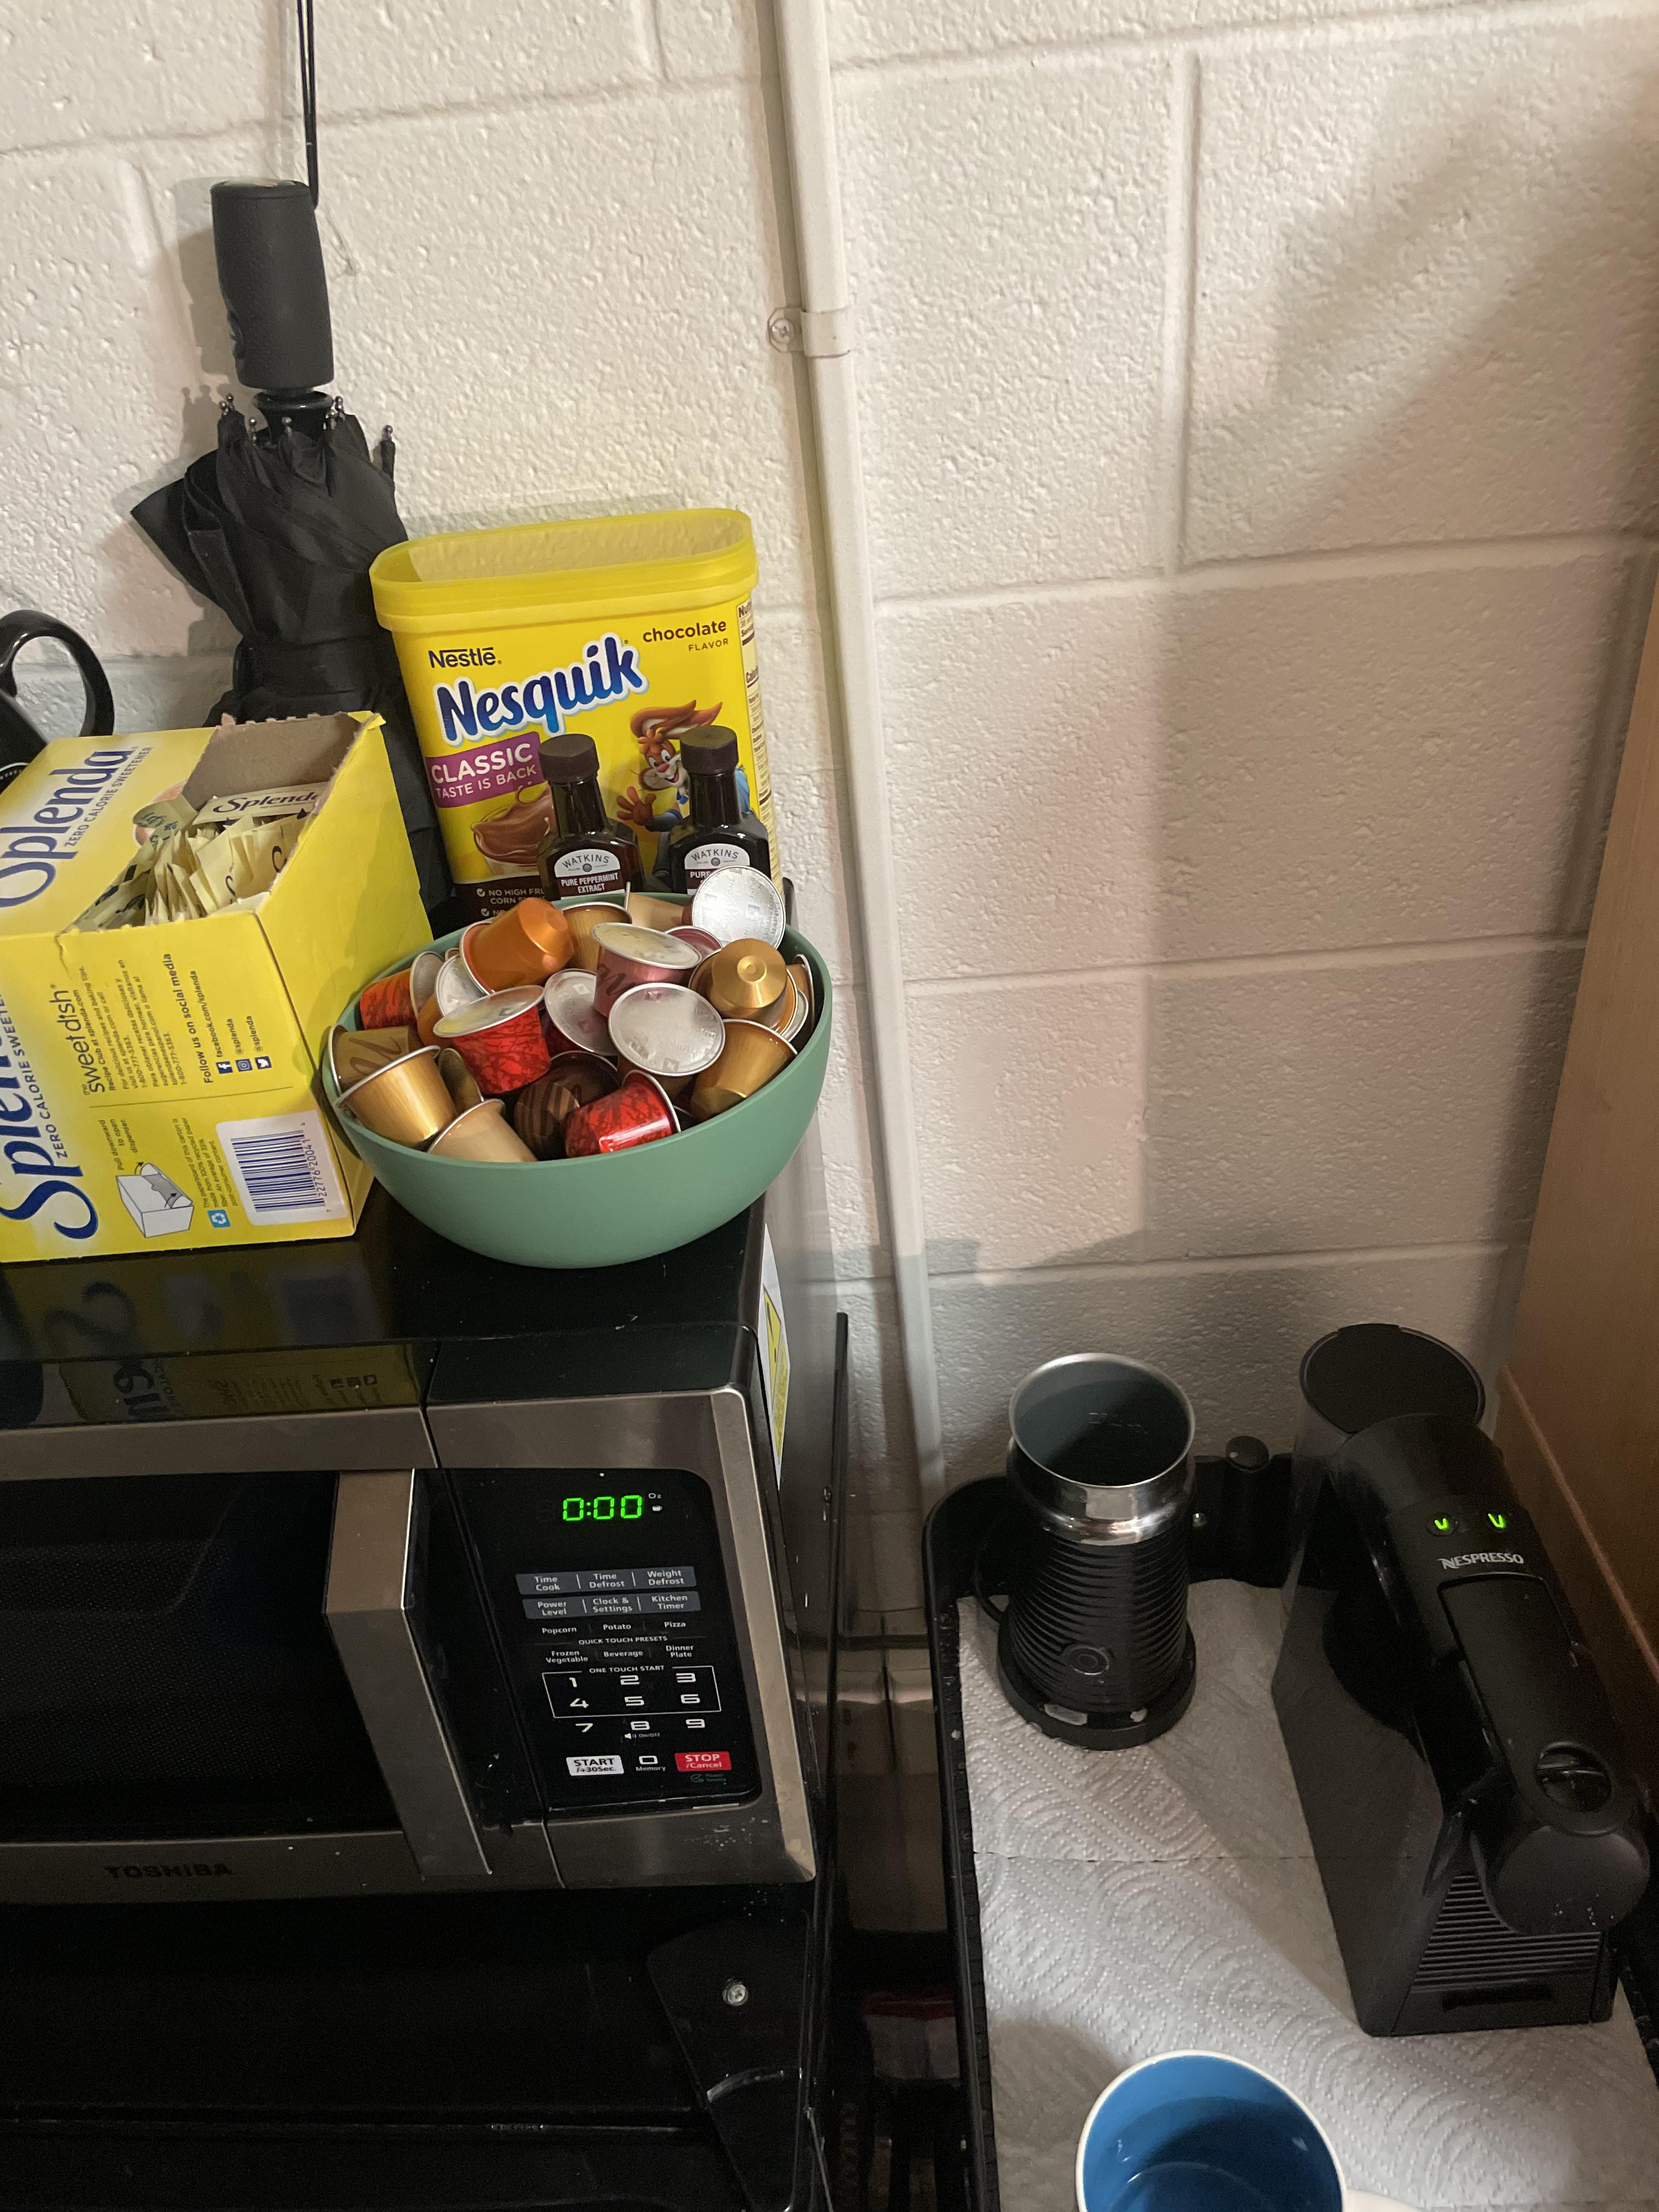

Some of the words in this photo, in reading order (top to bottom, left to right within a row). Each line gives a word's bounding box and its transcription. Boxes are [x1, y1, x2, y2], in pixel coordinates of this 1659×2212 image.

[642, 619, 727, 643] chocolate
[688, 637, 729, 652] FLAVOR
[437, 635, 646, 743] Nesquik
[431, 742, 534, 785] CLASSIC
[436, 781, 476, 799] TASTE
[478, 777, 492, 791] IS
[495, 764, 537, 788] BACK
[64, 824, 89, 847] ZERO
[84, 788, 118, 823] CALORIE
[112, 747, 154, 787] SWEETENER
[562, 854, 610, 869] WATKINS
[691, 849, 739, 861] WATKINS
[561, 878, 578, 887] PURE
[579, 872, 619, 886] PEPPERMINT
[577, 883, 605, 894] EXTRACT
[162, 953, 180, 986] media
[49, 990, 82, 1031] dish
[173, 989, 191, 1018] social
[73, 990, 95, 1037] splenda.com
[190, 970, 223, 1058] facebook.com/splenda
[187, 1022, 196, 1034] on
[245, 1015, 263, 1052] @splenda
[192, 1037, 201, 1048] us
[225, 1018, 244, 1055] @splenda
[65, 1035, 105, 1092] sweet
[95, 1048, 106, 1065] Club
[196, 1051, 213, 1084] Follow
[103, 1066, 116, 1091] Recipe
[19, 1060, 51, 1120] CALORIE
[110, 1119, 121, 1137] open
[45, 1124, 68, 1159] ZERO
[98, 1120, 119, 1156] downward
[302, 1139, 319, 1168] 20041
[114, 1158, 125, 1170] Pull
[312, 1170, 328, 1198] 22776
[562, 1494, 642, 1521] 0:00
[1437, 1552, 1525, 1570] NESPRESSO
[647, 1570, 682, 1578] Weight
[648, 1577, 685, 1586] Defrost
[589, 1580, 625, 1589] Defrost
[592, 1597, 618, 1605] Clock
[651, 1594, 687, 1602] Kitchen
[541, 1608, 567, 1616] Level
[592, 1604, 633, 1614] Settings
[541, 1626, 577, 1634] Popcorn
[545, 1656, 589, 1664] Vegetable
[569, 1677, 577, 1688] 1
[620, 1675, 640, 1685] 2
[675, 1673, 696, 1683] 3
[569, 1698, 589, 1709] 4
[624, 1696, 645, 1706] 5
[680, 1694, 701, 1704] 6
[575, 1723, 593, 1733] 7
[630, 1720, 651, 1731] 8
[685, 1718, 706, 1729] 9
[574, 1757, 615, 1767] START
[639, 1755, 658, 1765] 0
[685, 1753, 720, 1762] STOP
[686, 1761, 723, 1769] /Cancel
[104, 1863, 234, 1878] TOSHIBA
